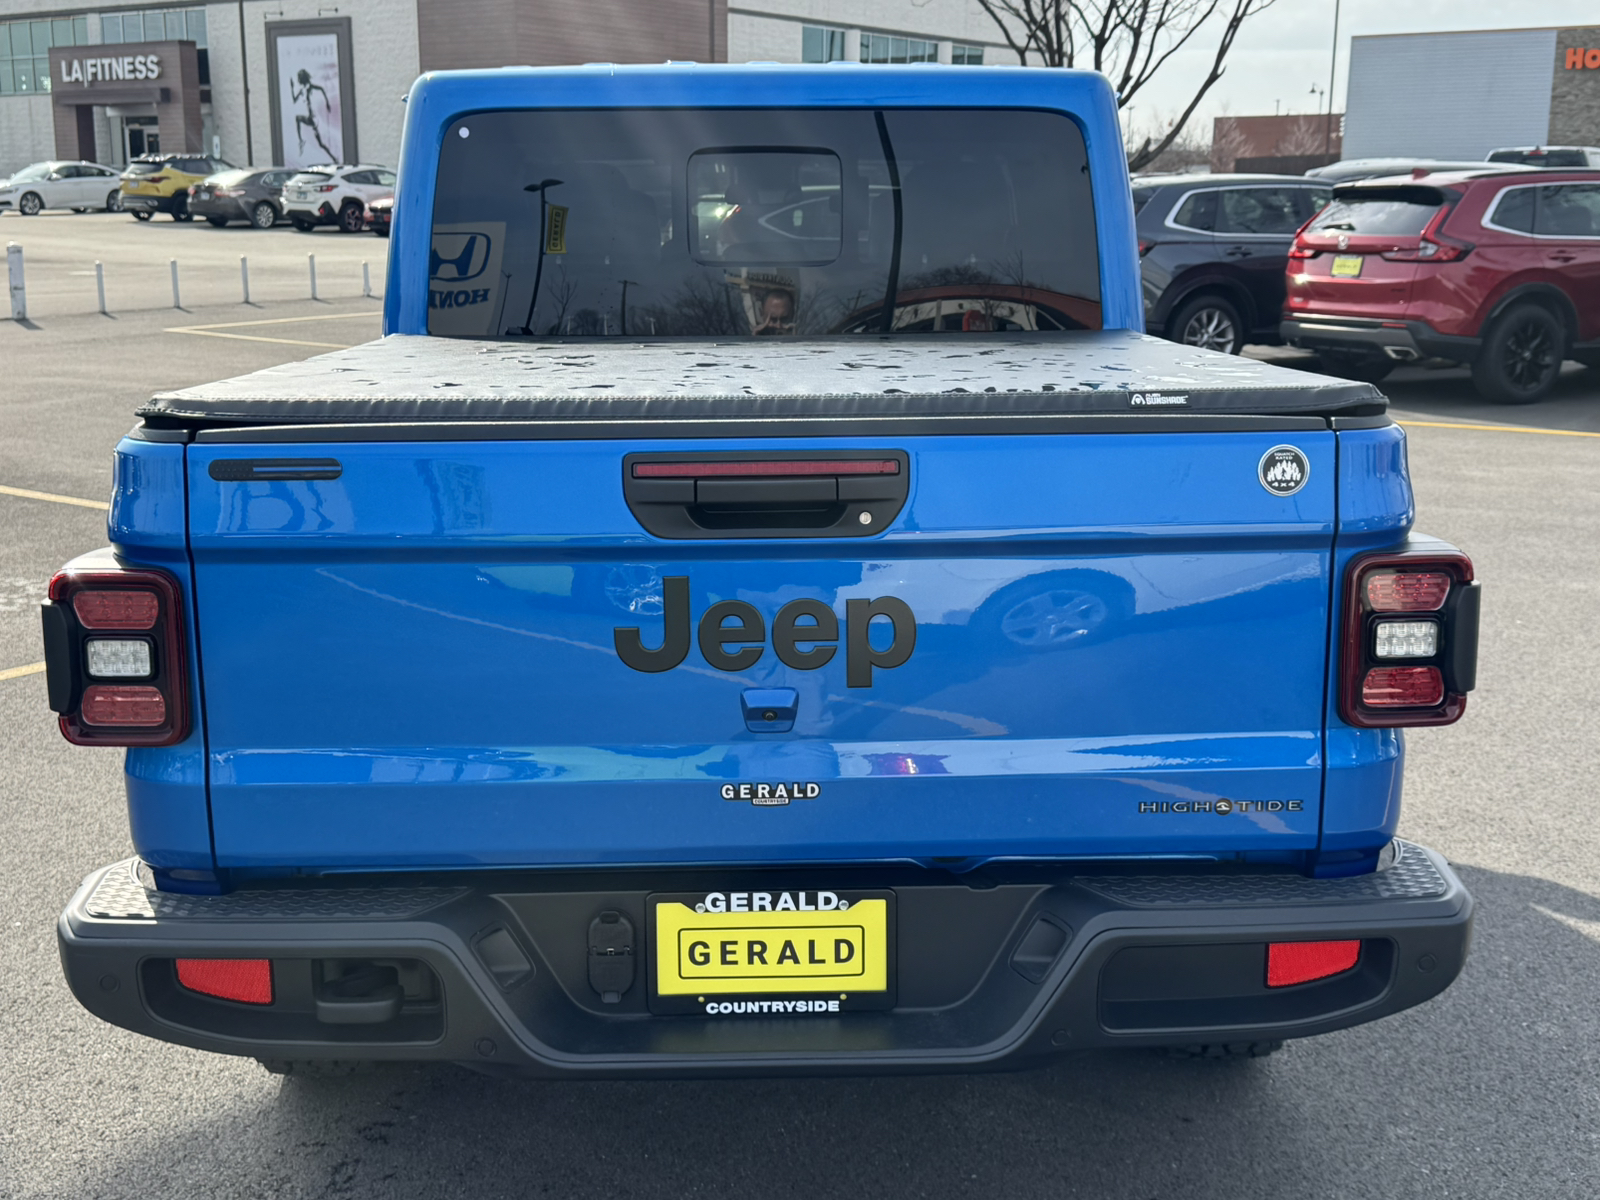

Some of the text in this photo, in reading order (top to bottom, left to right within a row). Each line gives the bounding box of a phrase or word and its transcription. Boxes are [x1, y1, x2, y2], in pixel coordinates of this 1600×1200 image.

[613, 575, 917, 688] Jeep
[721, 783, 820, 799] GERALD
[1139, 800, 1303, 813] HIGH TIDE
[705, 891, 839, 913] GERALD
[688, 938, 855, 966] GERALD
[705, 1000, 840, 1014] COUNTRYSIDE
